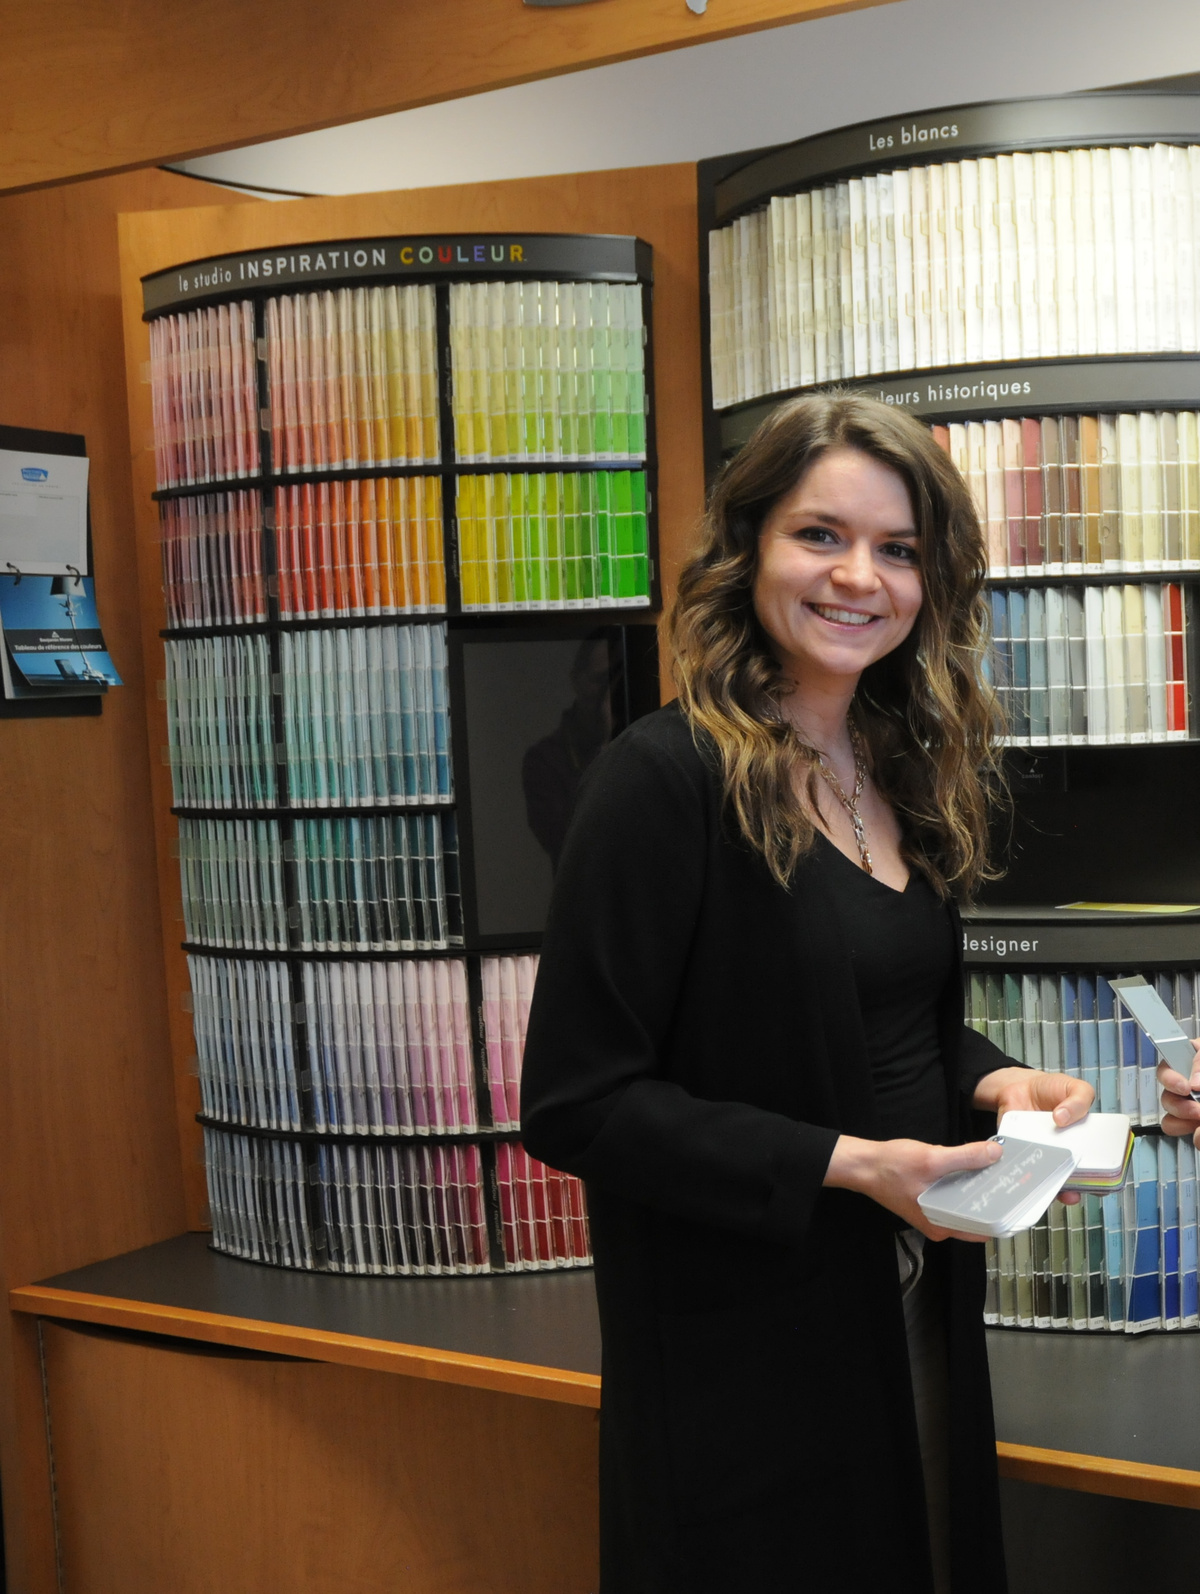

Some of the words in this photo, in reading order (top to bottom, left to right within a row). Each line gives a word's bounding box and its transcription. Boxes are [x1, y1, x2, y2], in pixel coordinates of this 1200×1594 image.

[869, 134, 894, 151] Les
[900, 124, 959, 145] blancs
[178, 275, 189, 292] le
[194, 267, 232, 289] studio
[239, 249, 386, 280] INSPIRATION
[400, 244, 524, 265] COULEUR
[928, 381, 1031, 401] historiques
[45, 643, 70, 651] référence
[962, 932, 1039, 956] designer
